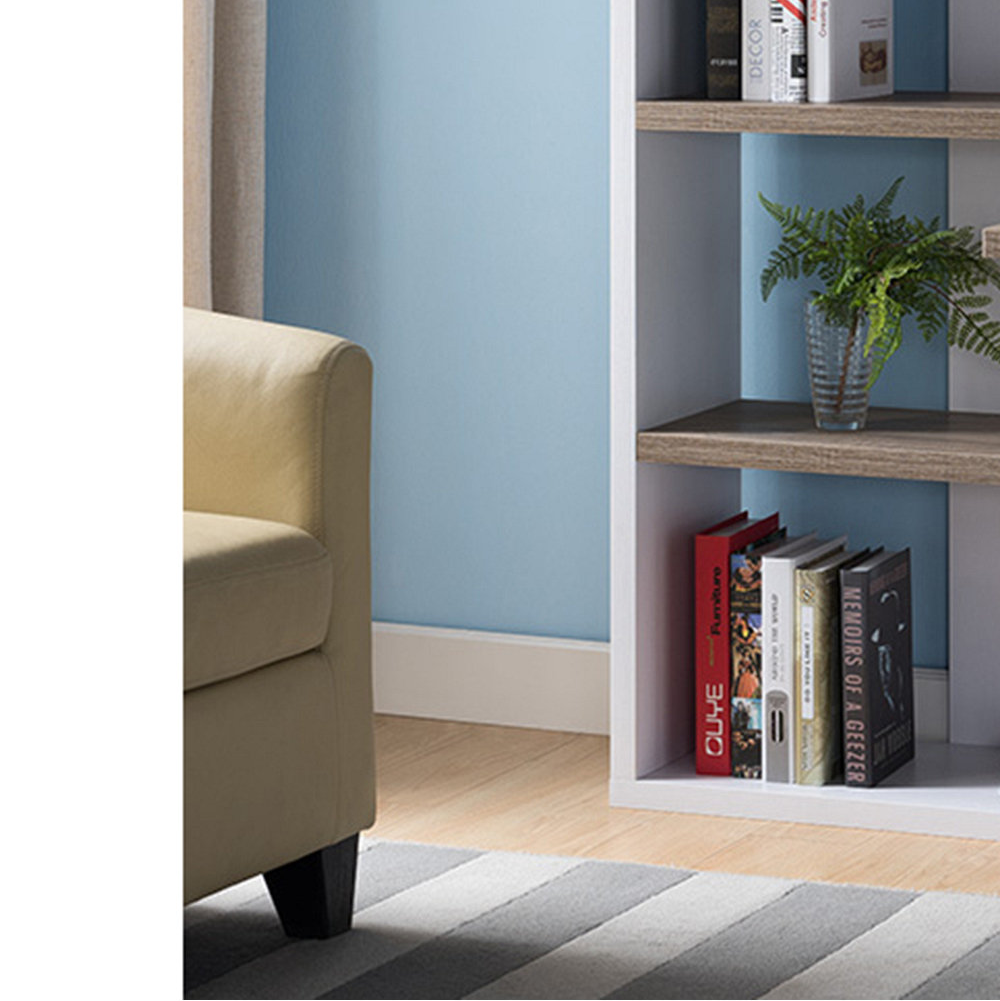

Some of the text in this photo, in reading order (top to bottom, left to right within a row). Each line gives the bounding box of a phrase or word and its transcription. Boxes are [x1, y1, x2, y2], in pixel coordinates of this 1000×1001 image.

[711, 566, 722, 636] Furniture
[705, 683, 724, 756] OUYE
[843, 586, 866, 783] MEMOIRS OF A GEEZER
